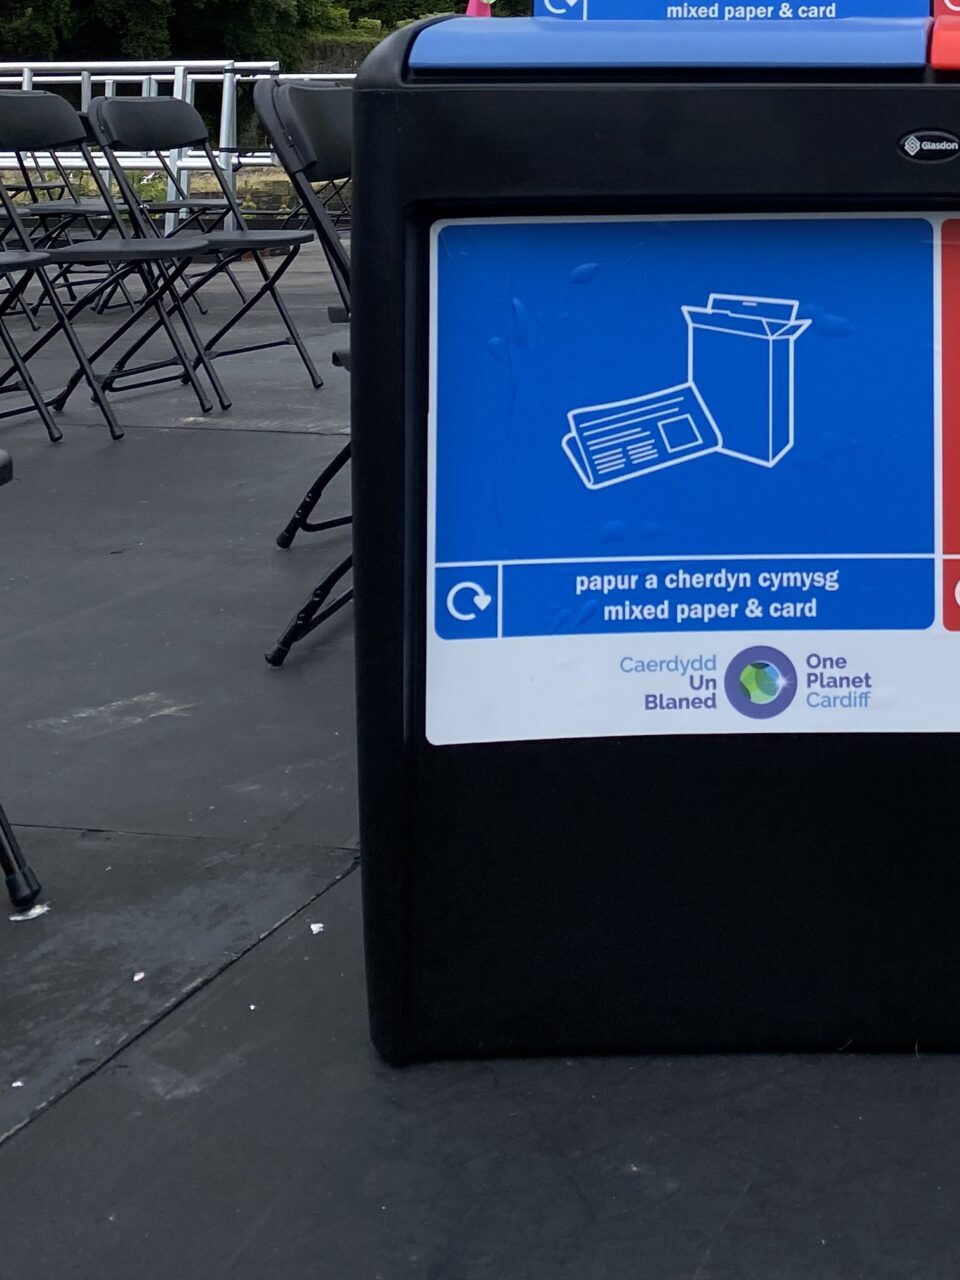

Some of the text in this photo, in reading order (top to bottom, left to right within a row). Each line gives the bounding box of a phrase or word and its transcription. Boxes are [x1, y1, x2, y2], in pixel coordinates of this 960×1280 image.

[667, 3, 836, 20] mixed paper & card
[921, 141, 959, 150] Glasdon
[576, 569, 839, 595] papur a cherdyn cymysg
[604, 598, 817, 623] mixed paper & card
[620, 655, 717, 676] Caerdydd
[806, 653, 847, 669] One
[689, 675, 717, 691] Un
[806, 672, 872, 688] Planet
[644, 693, 717, 710] Blaned
[806, 691, 871, 708] Cardiff
